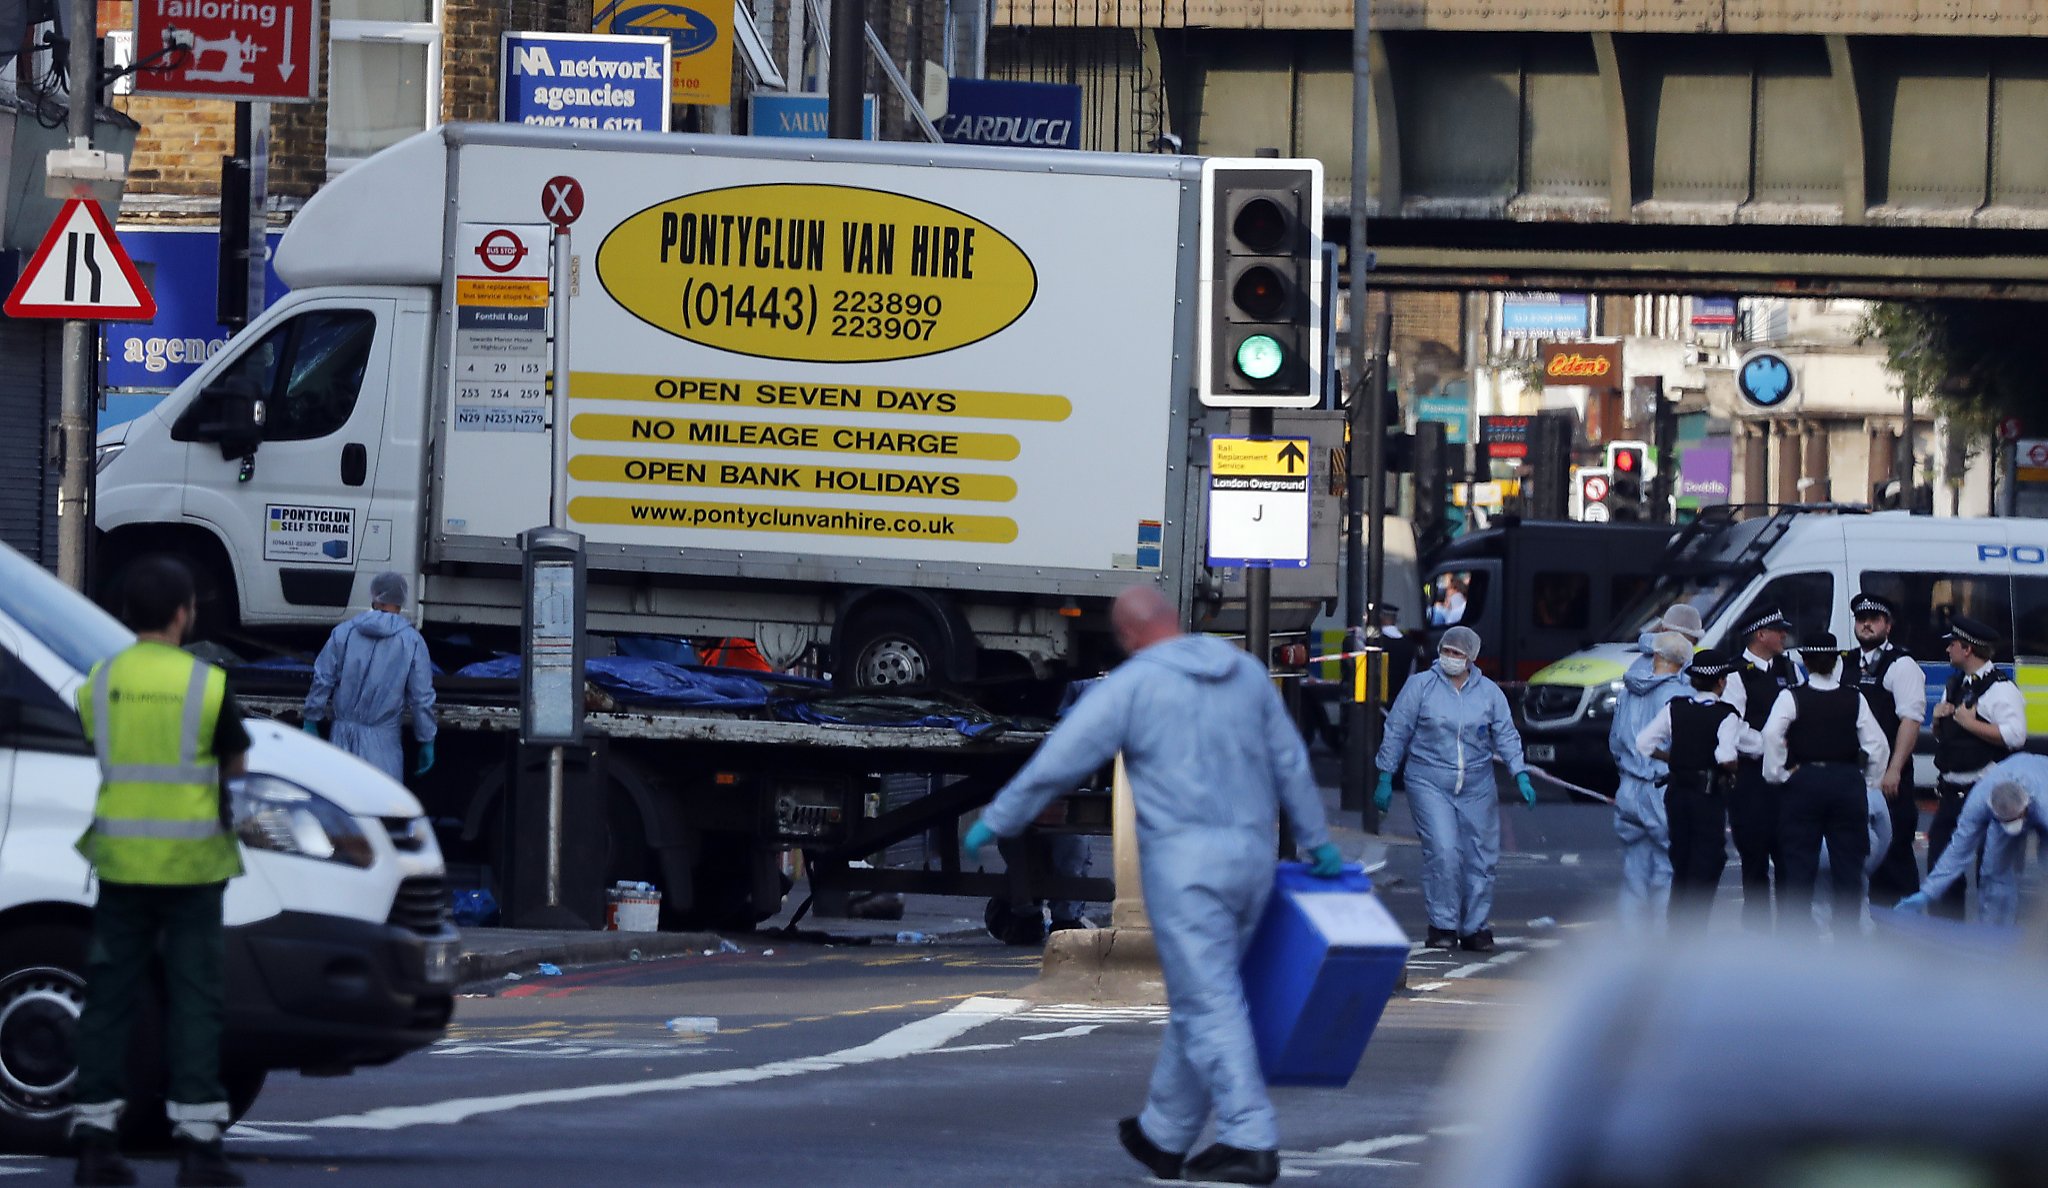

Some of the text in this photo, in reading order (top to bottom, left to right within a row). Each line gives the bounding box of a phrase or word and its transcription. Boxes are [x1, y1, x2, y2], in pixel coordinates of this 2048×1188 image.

[157, 0, 277, 27] Tailoring
[559, 56, 662, 80] network
[533, 83, 635, 110] agencies
[940, 114, 1072, 145] CARDUCCI
[549, 184, 574, 217] X
[486, 247, 518, 255] BUS STOP
[660, 211, 975, 279] PONTYCLUN VAN HIRE
[486, 283, 530, 292] replacement
[682, 277, 942, 335] (01443) 223890
[475, 312, 529, 322] Fonthill Road
[831, 315, 937, 341] 223907
[124, 331, 231, 372] agenc
[494, 363, 507, 373] 29
[521, 364, 539, 373] 153
[461, 389, 540, 399] 253 254 259
[655, 379, 957, 413] OPEN SEVEN DAYS
[459, 413, 544, 424] N29 N253 N279
[631, 419, 959, 455] NO MILEAGE CHARGE
[1217, 444, 1233, 452] Rail
[1217, 453, 1268, 461] Replacement
[624, 460, 960, 496] OPEN BANK HOLIDAYS
[1213, 478, 1306, 491] London Overground
[282, 508, 350, 523] PONTYCLUN
[631, 504, 955, 535] www.pontyclunvanhire.co.uk
[1252, 504, 1263, 522] J
[281, 521, 350, 534] SELF STORAGE
[1977, 545, 2048, 563] PO
